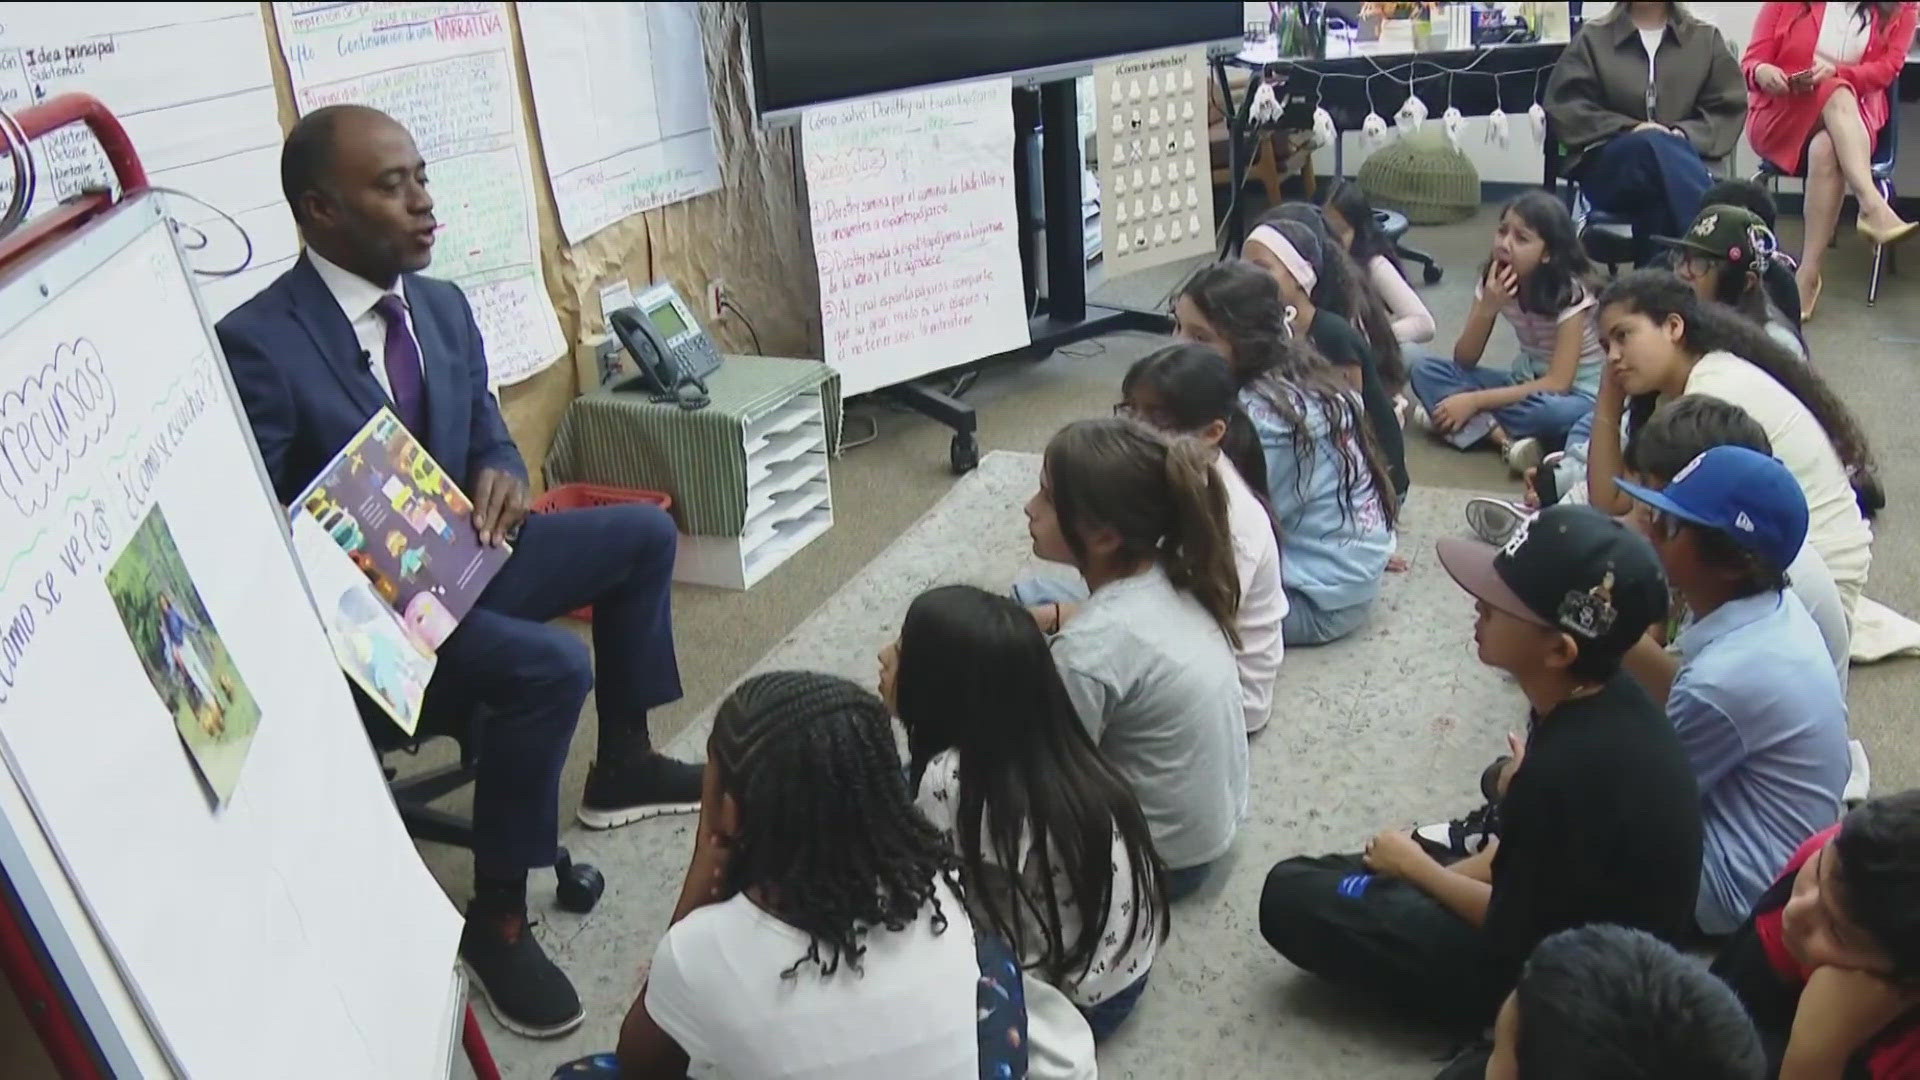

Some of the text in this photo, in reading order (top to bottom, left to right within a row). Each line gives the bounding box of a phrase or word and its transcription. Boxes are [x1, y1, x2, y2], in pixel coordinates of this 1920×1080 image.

[433, 14, 503, 43] NARRATIVA
[25, 45, 61, 67] Idea
[809, 112, 837, 131] Cómo
[872, 99, 912, 119] Dorothy
[54, 161, 92, 181] Detalle
[826, 194, 861, 226] Dorothy
[839, 297, 851, 319] Al
[932, 301, 946, 314] un
[0, 357, 104, 486] recursos
[35, 570, 62, 616] se
[59, 510, 94, 577] ve?
